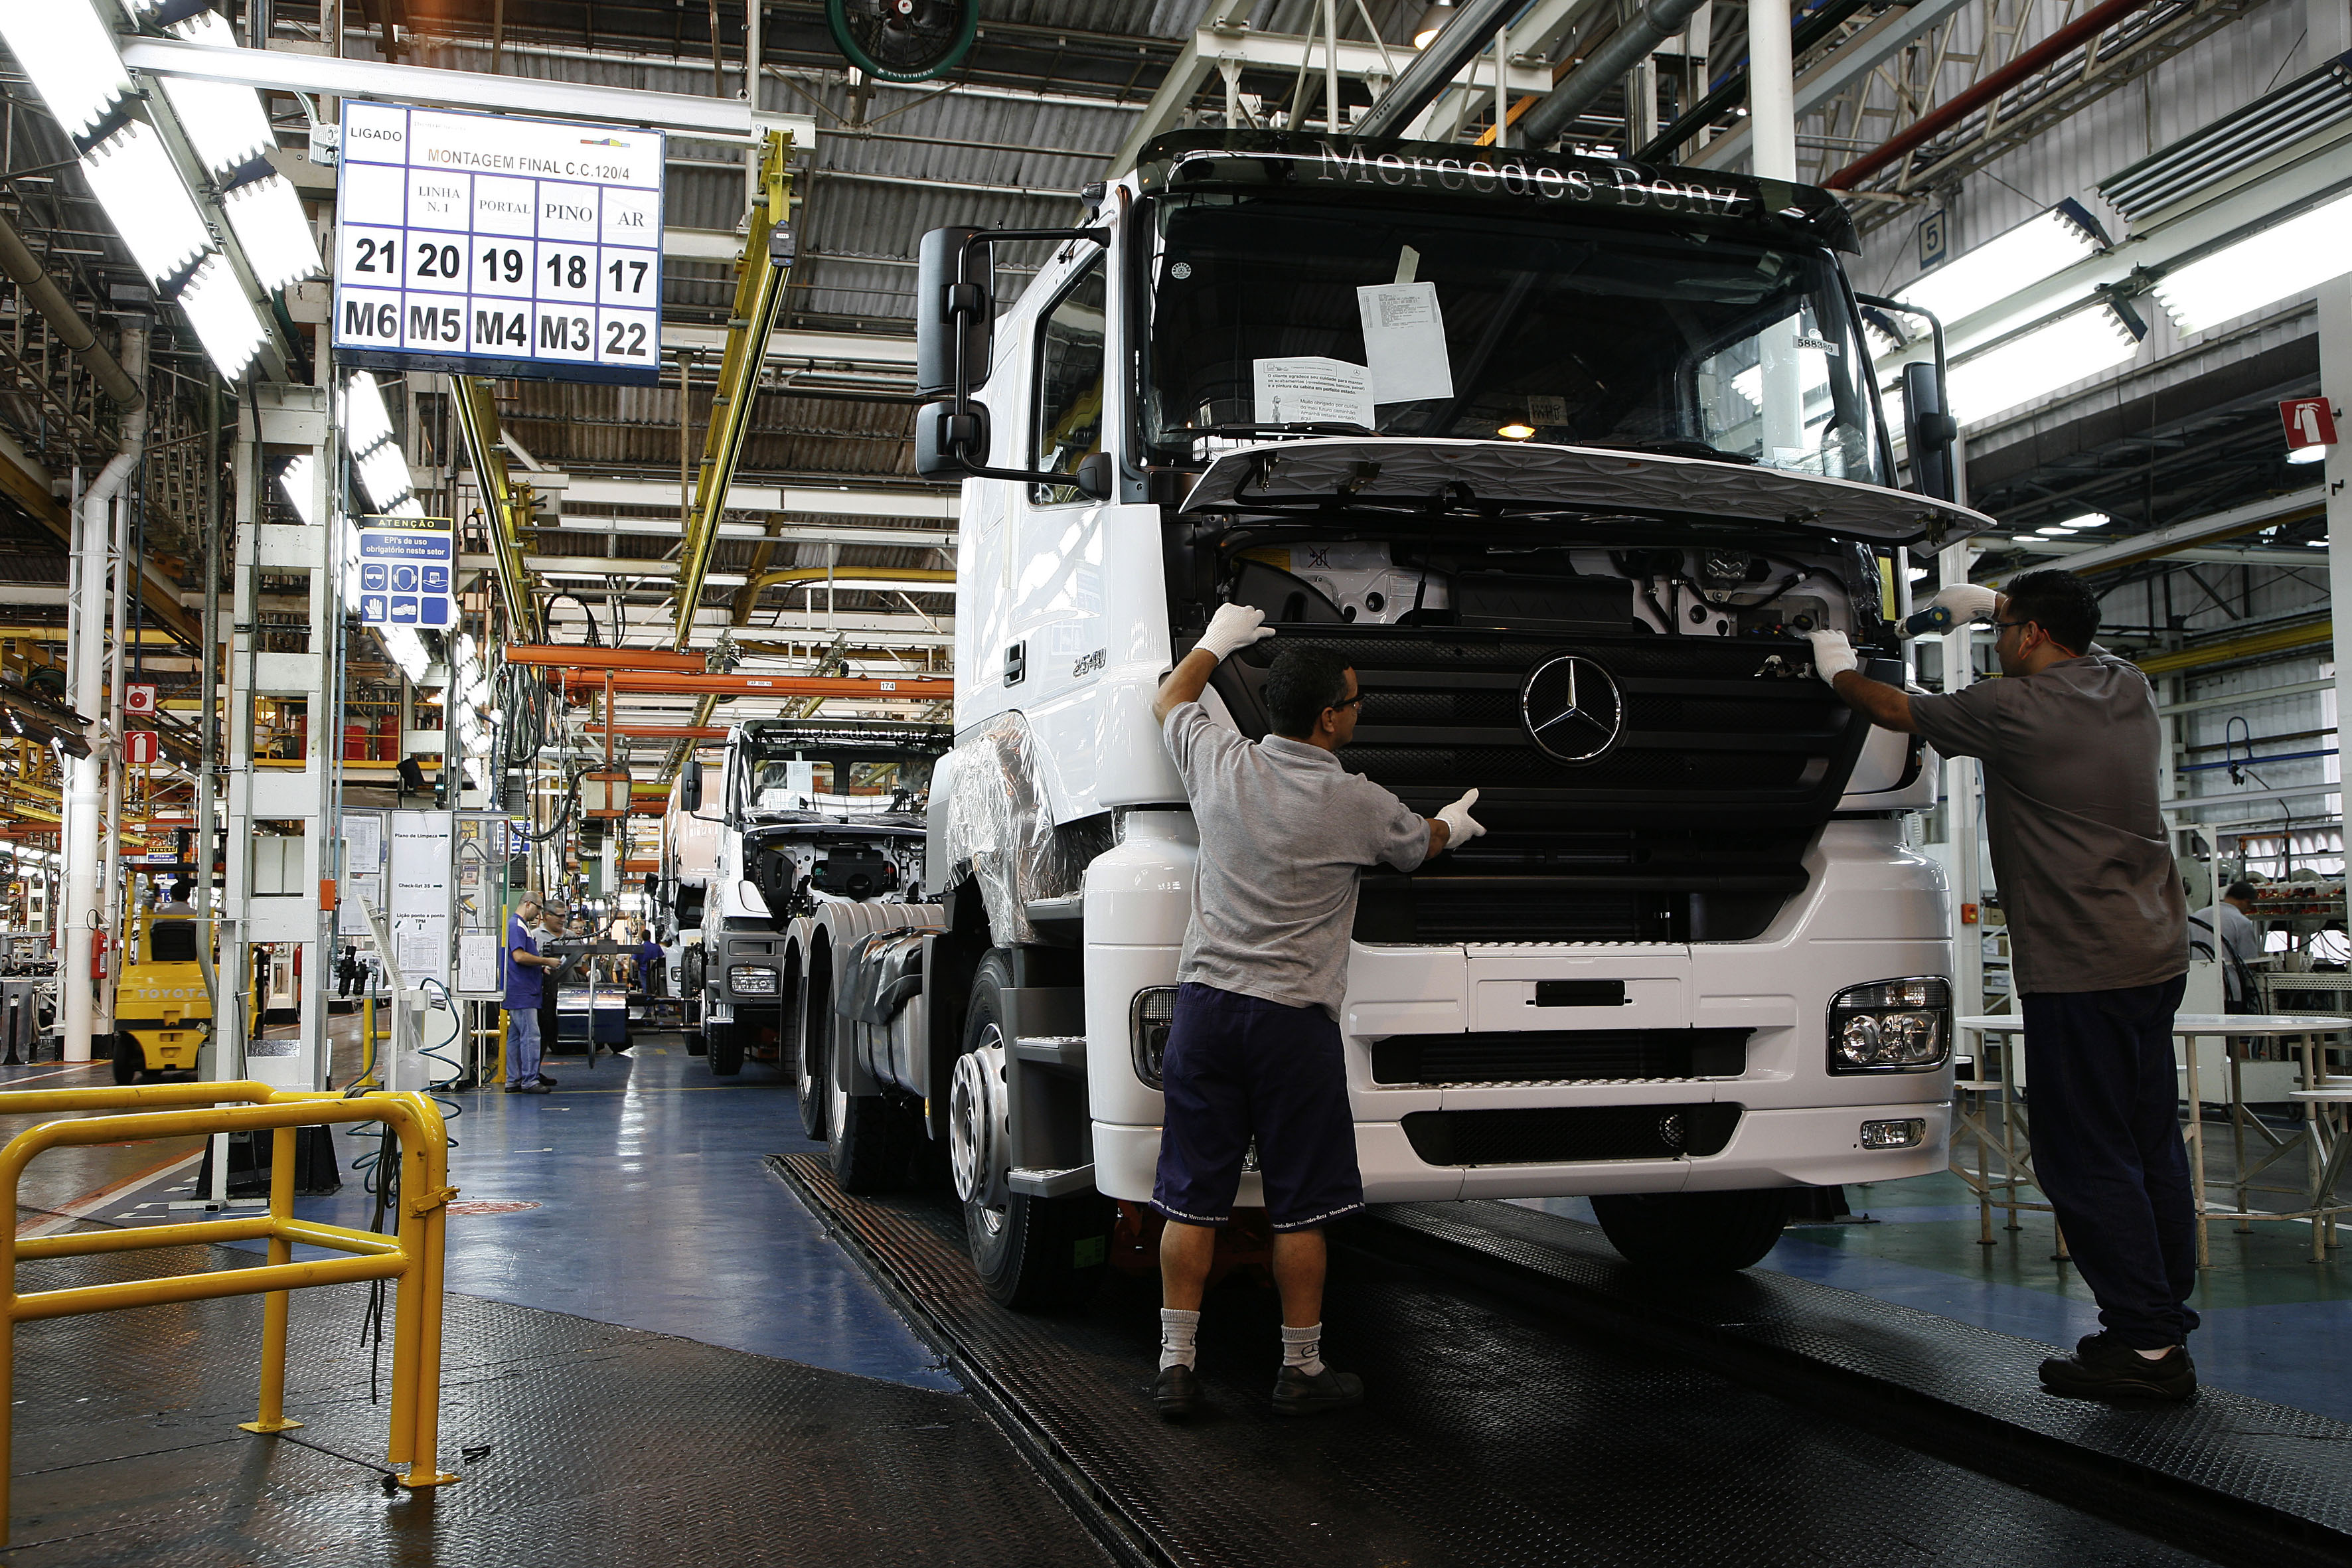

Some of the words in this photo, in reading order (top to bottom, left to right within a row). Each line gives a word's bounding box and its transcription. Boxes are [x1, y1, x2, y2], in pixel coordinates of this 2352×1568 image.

[351, 127, 402, 142] LIGADO
[428, 148, 514, 169] MONTAGEM
[519, 157, 561, 175] FINAL
[566, 162, 630, 181] C.C.120/4
[418, 185, 460, 199] LINHA
[1314, 140, 1594, 201] Mercedes
[1607, 166, 1743, 218] Benz
[427, 201, 441, 212] N.
[443, 202, 449, 213] 1
[479, 198, 530, 215] PORTAL
[545, 202, 593, 223] PINO
[617, 211, 645, 227] AR
[1927, 223, 1938, 251] 5
[355, 238, 395, 274] 21
[417, 244, 459, 279] 20
[483, 248, 522, 283] 19
[547, 254, 586, 289] 18
[609, 260, 648, 293] 17
[345, 301, 397, 338] M6
[410, 305, 461, 342] M5
[475, 311, 526, 347] M4
[540, 315, 589, 351] M3
[606, 321, 647, 356] 22
[1798, 339, 1833, 353] 588389
[378, 519, 435, 528] ATENÇÃO
[366, 546, 404, 555] obrigatório
[793, 728, 879, 740] Mercedes
[887, 729, 929, 740] Benz
[138, 988, 208, 998] TOYOTA
[1329, 1204, 1358, 1216] Mercedes-Benz
